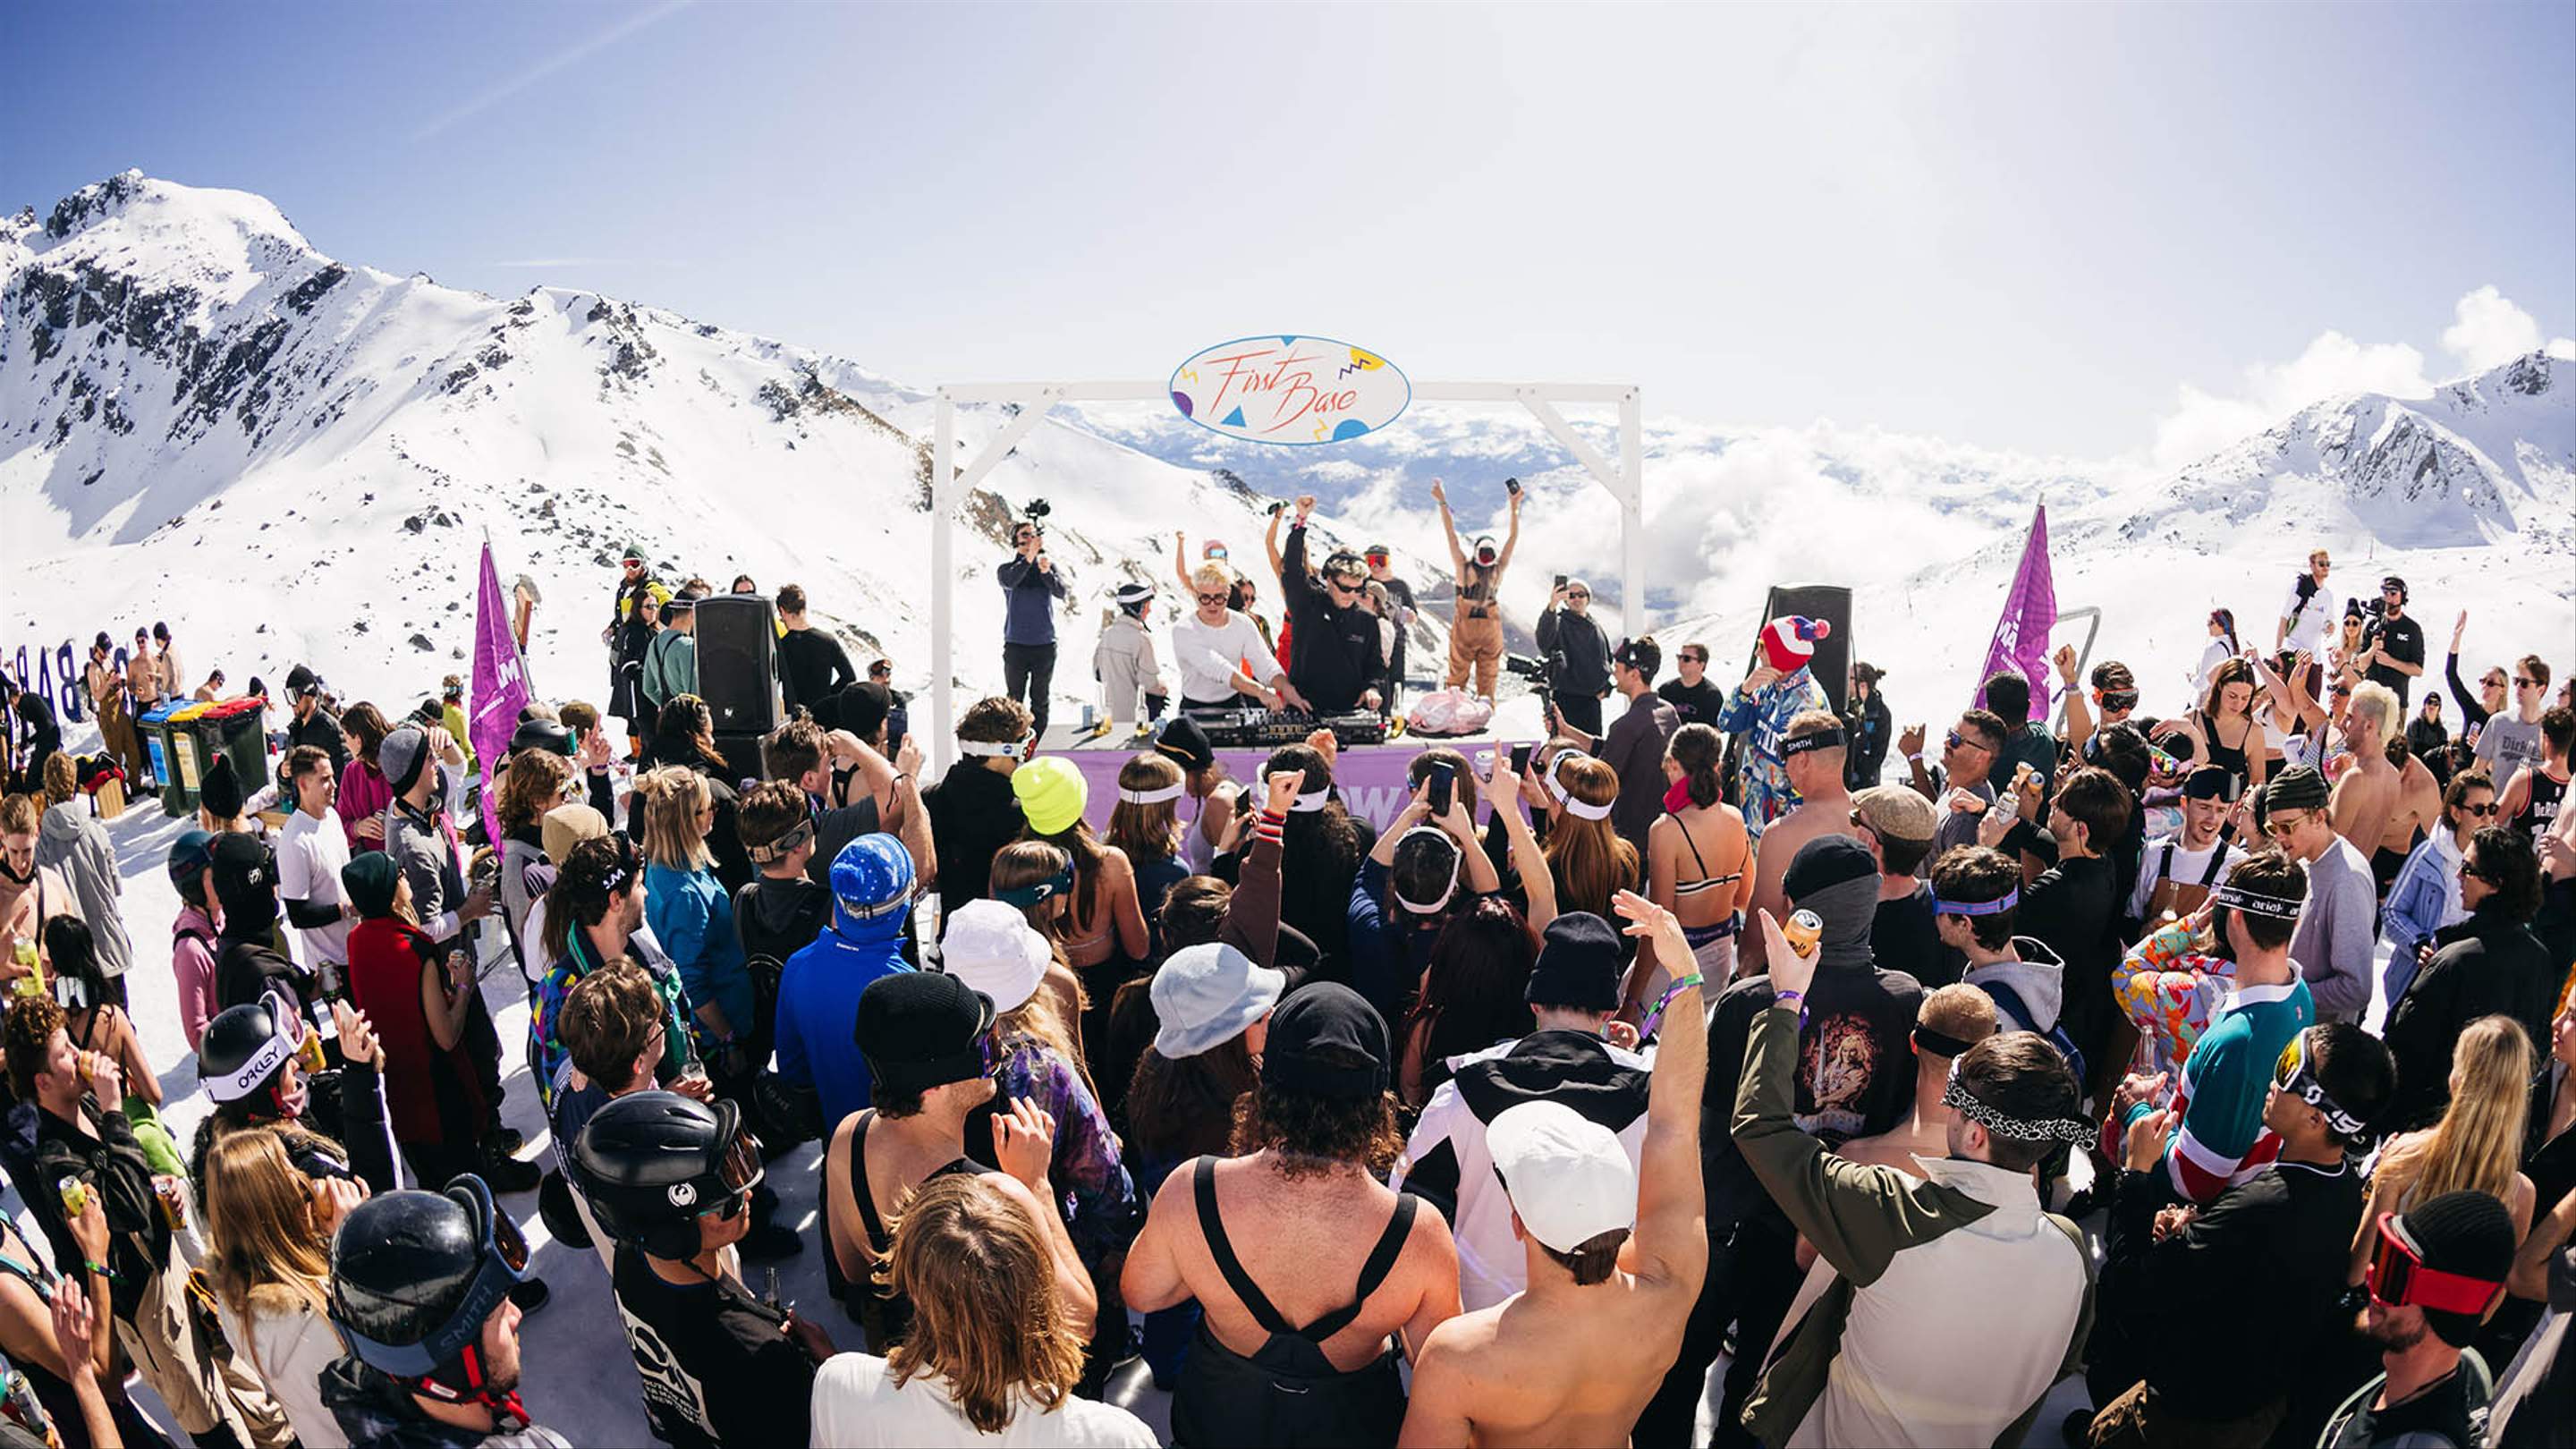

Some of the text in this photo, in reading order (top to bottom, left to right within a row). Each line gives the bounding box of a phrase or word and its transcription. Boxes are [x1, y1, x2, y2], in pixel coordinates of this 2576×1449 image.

[1204, 347, 1324, 416] First
[1259, 371, 1357, 434] Base
[1787, 738, 1813, 752] SMITH
[238, 1045, 278, 1089] OAKLEY
[440, 1285, 493, 1347] SMITH
